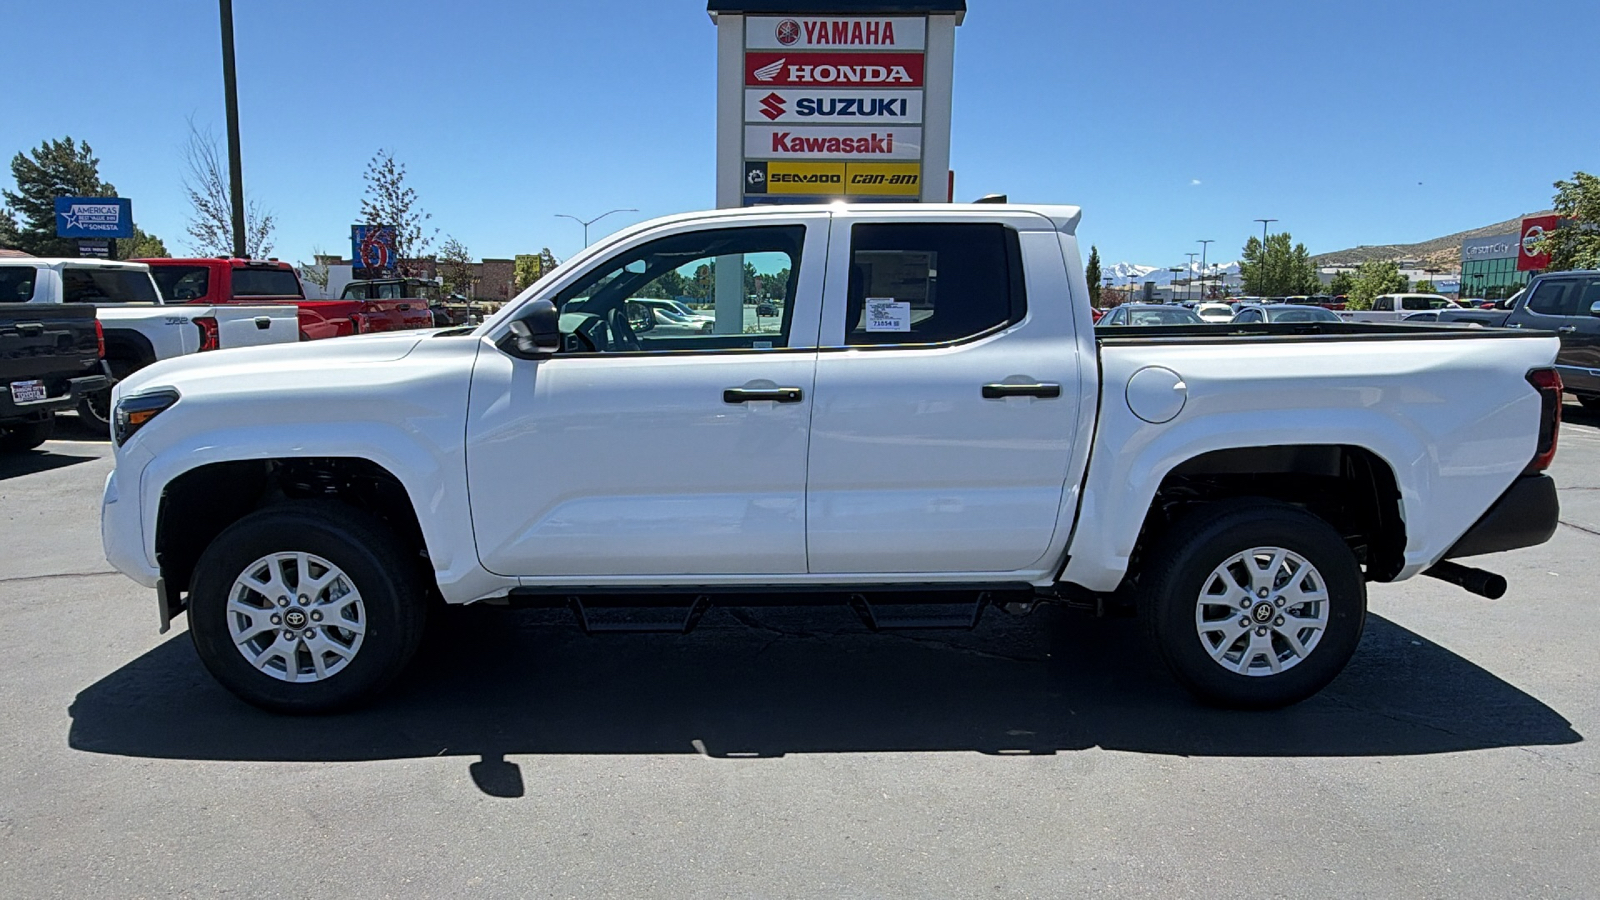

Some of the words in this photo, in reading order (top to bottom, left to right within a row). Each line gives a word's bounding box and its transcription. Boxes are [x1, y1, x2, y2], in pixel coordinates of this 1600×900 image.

[803, 21, 895, 45] YAMAHA
[787, 64, 914, 83] HONDA
[795, 98, 907, 116] SUZUKI
[772, 132, 893, 154] Kawasaki
[851, 173, 918, 185] can-am
[77, 206, 117, 215] AMERICAS
[89, 223, 118, 231] SONESTA
[360, 226, 389, 270] 6
[1466, 244, 1492, 255] Carson
[1493, 242, 1509, 254] City
